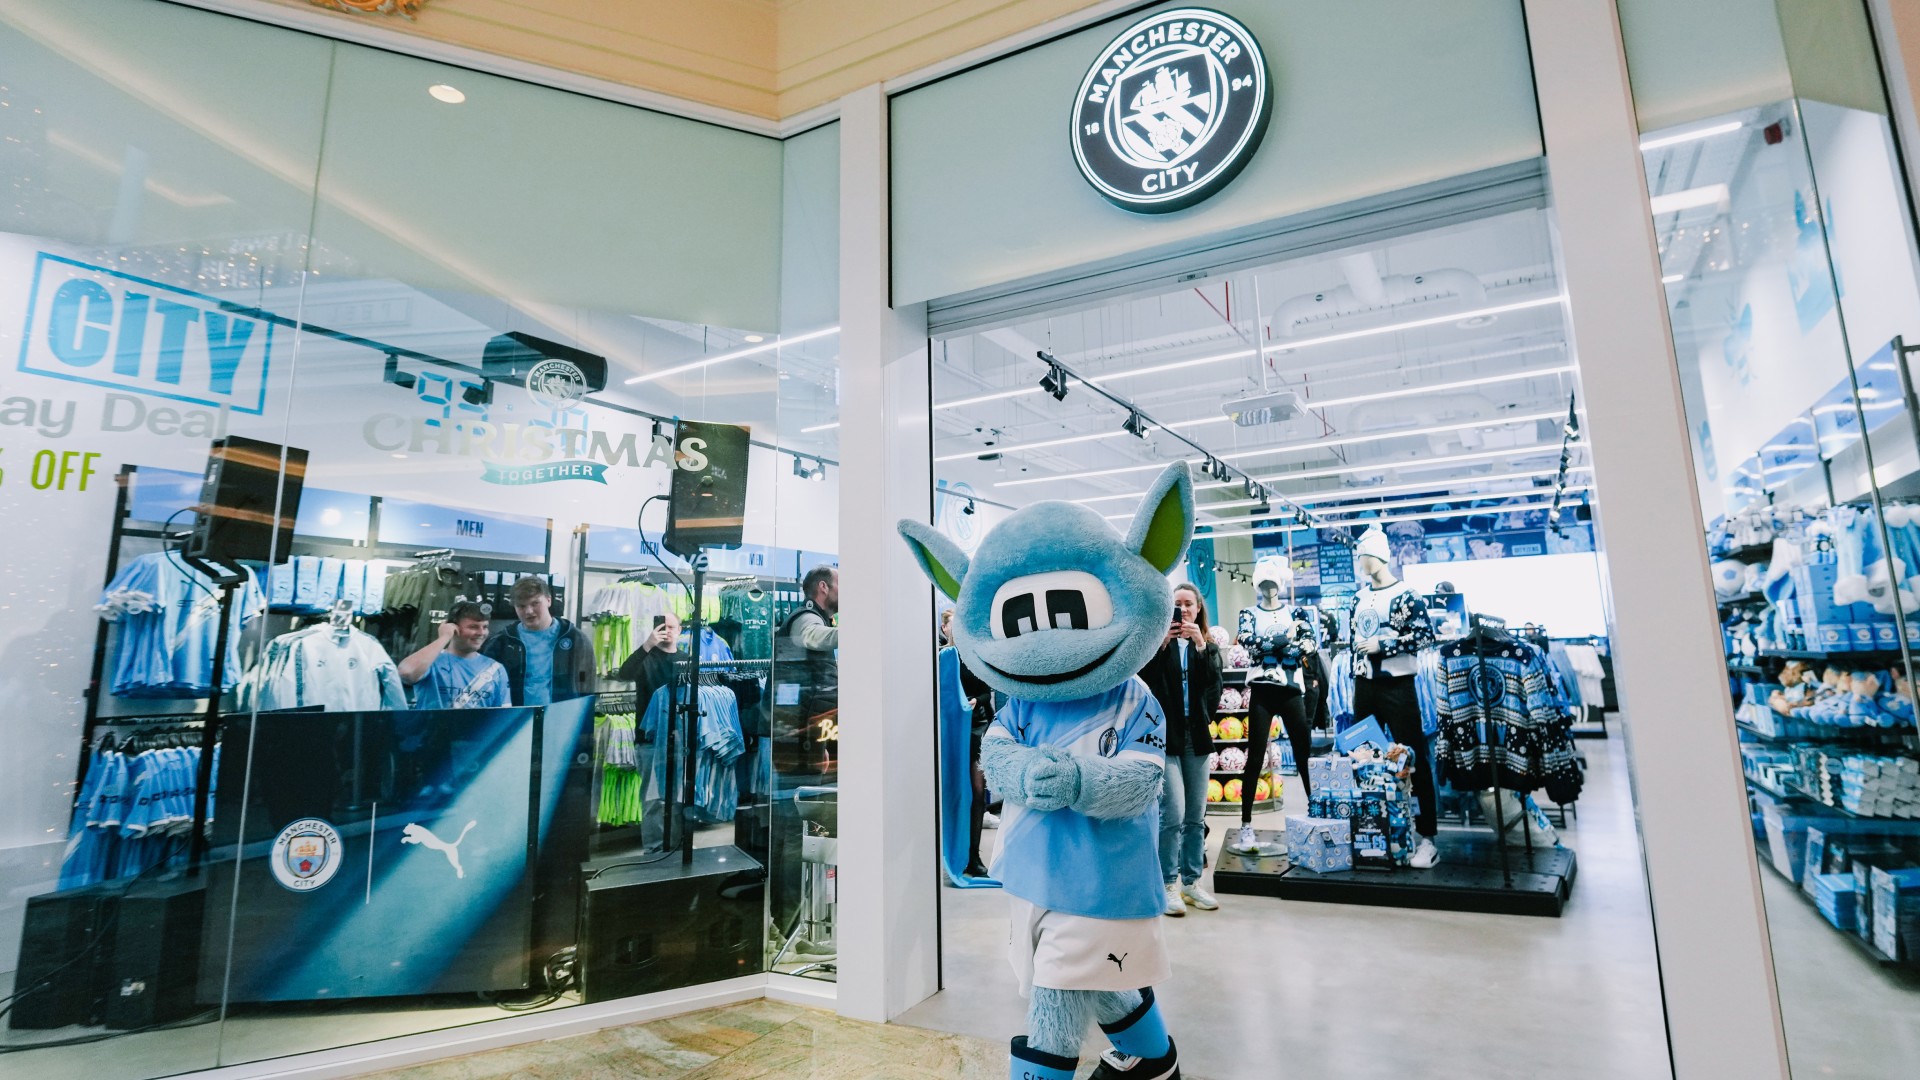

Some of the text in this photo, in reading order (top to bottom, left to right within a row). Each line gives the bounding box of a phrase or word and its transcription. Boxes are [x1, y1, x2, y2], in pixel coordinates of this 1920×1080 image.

[1089, 22, 1240, 103] MANCHESTER
[1231, 75, 1253, 91] 94
[1085, 122, 1100, 136] 18
[1142, 161, 1199, 193] CITY
[47, 277, 255, 396] CITY
[534, 363, 581, 381] MANCHESTER
[100, 392, 230, 440] Deal
[362, 412, 709, 472] CHRISTMAS
[31, 449, 102, 492] OFF
[498, 463, 594, 482] TOGETHER
[456, 518, 484, 538] MEN
[640, 540, 660, 556] MEN
[279, 823, 336, 846] MANCHESTER
[293, 879, 315, 887] CITY
